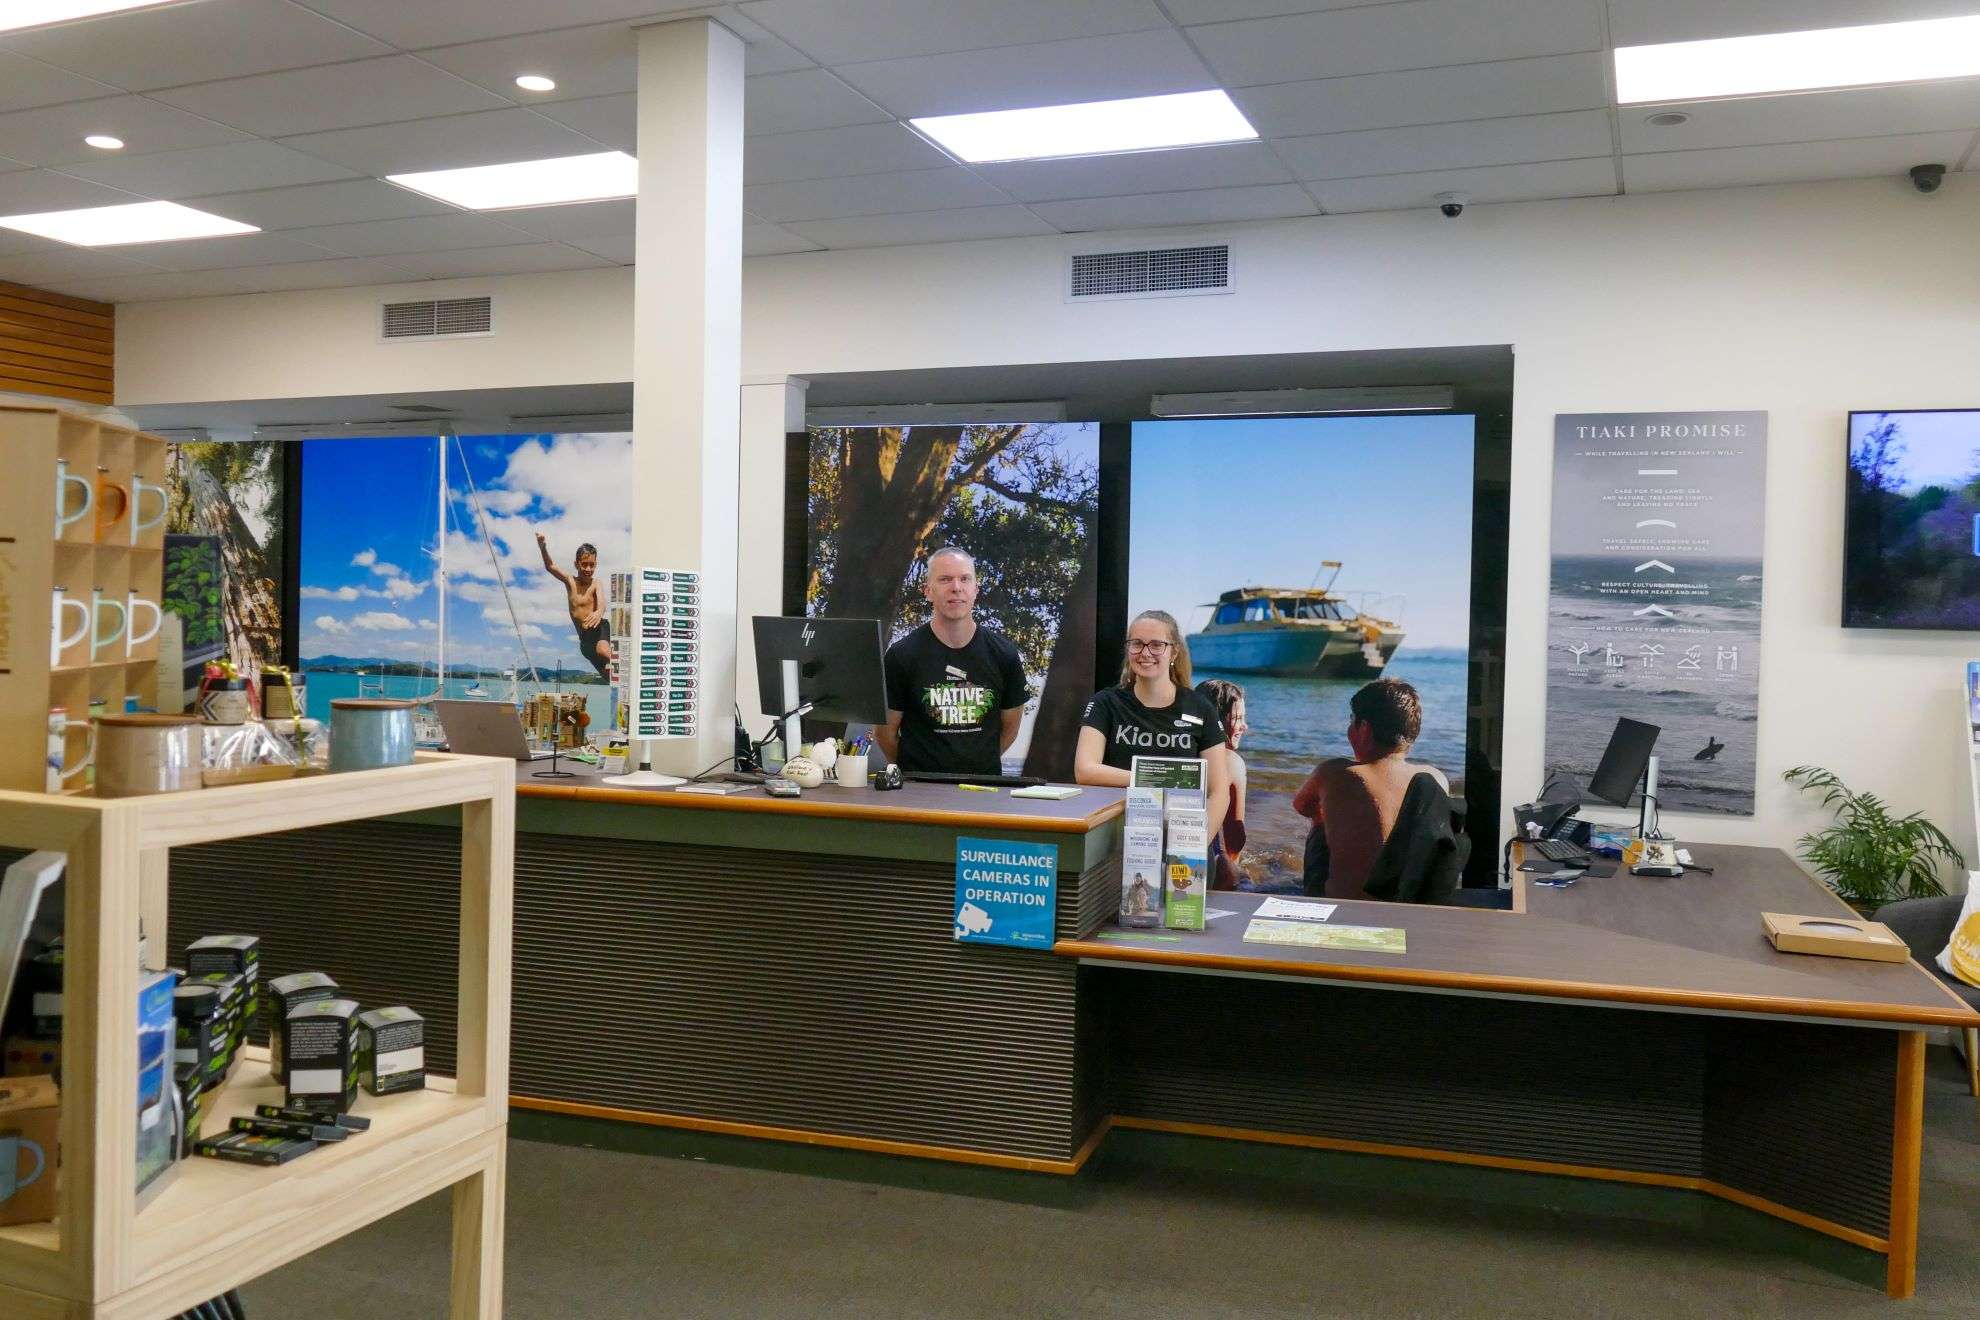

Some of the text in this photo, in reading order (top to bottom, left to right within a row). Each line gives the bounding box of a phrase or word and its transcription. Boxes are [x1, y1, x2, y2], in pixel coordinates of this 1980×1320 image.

[1576, 424, 1746, 439] TIAKI PROMISE
[930, 687, 985, 706] NATIVE
[939, 705, 977, 724] TREE
[1115, 725, 1192, 749] Kia ora
[960, 849, 1053, 869] SURVEILLANCE
[963, 868, 1050, 888] CAMERAS IN
[965, 888, 1046, 907] OPERATION
